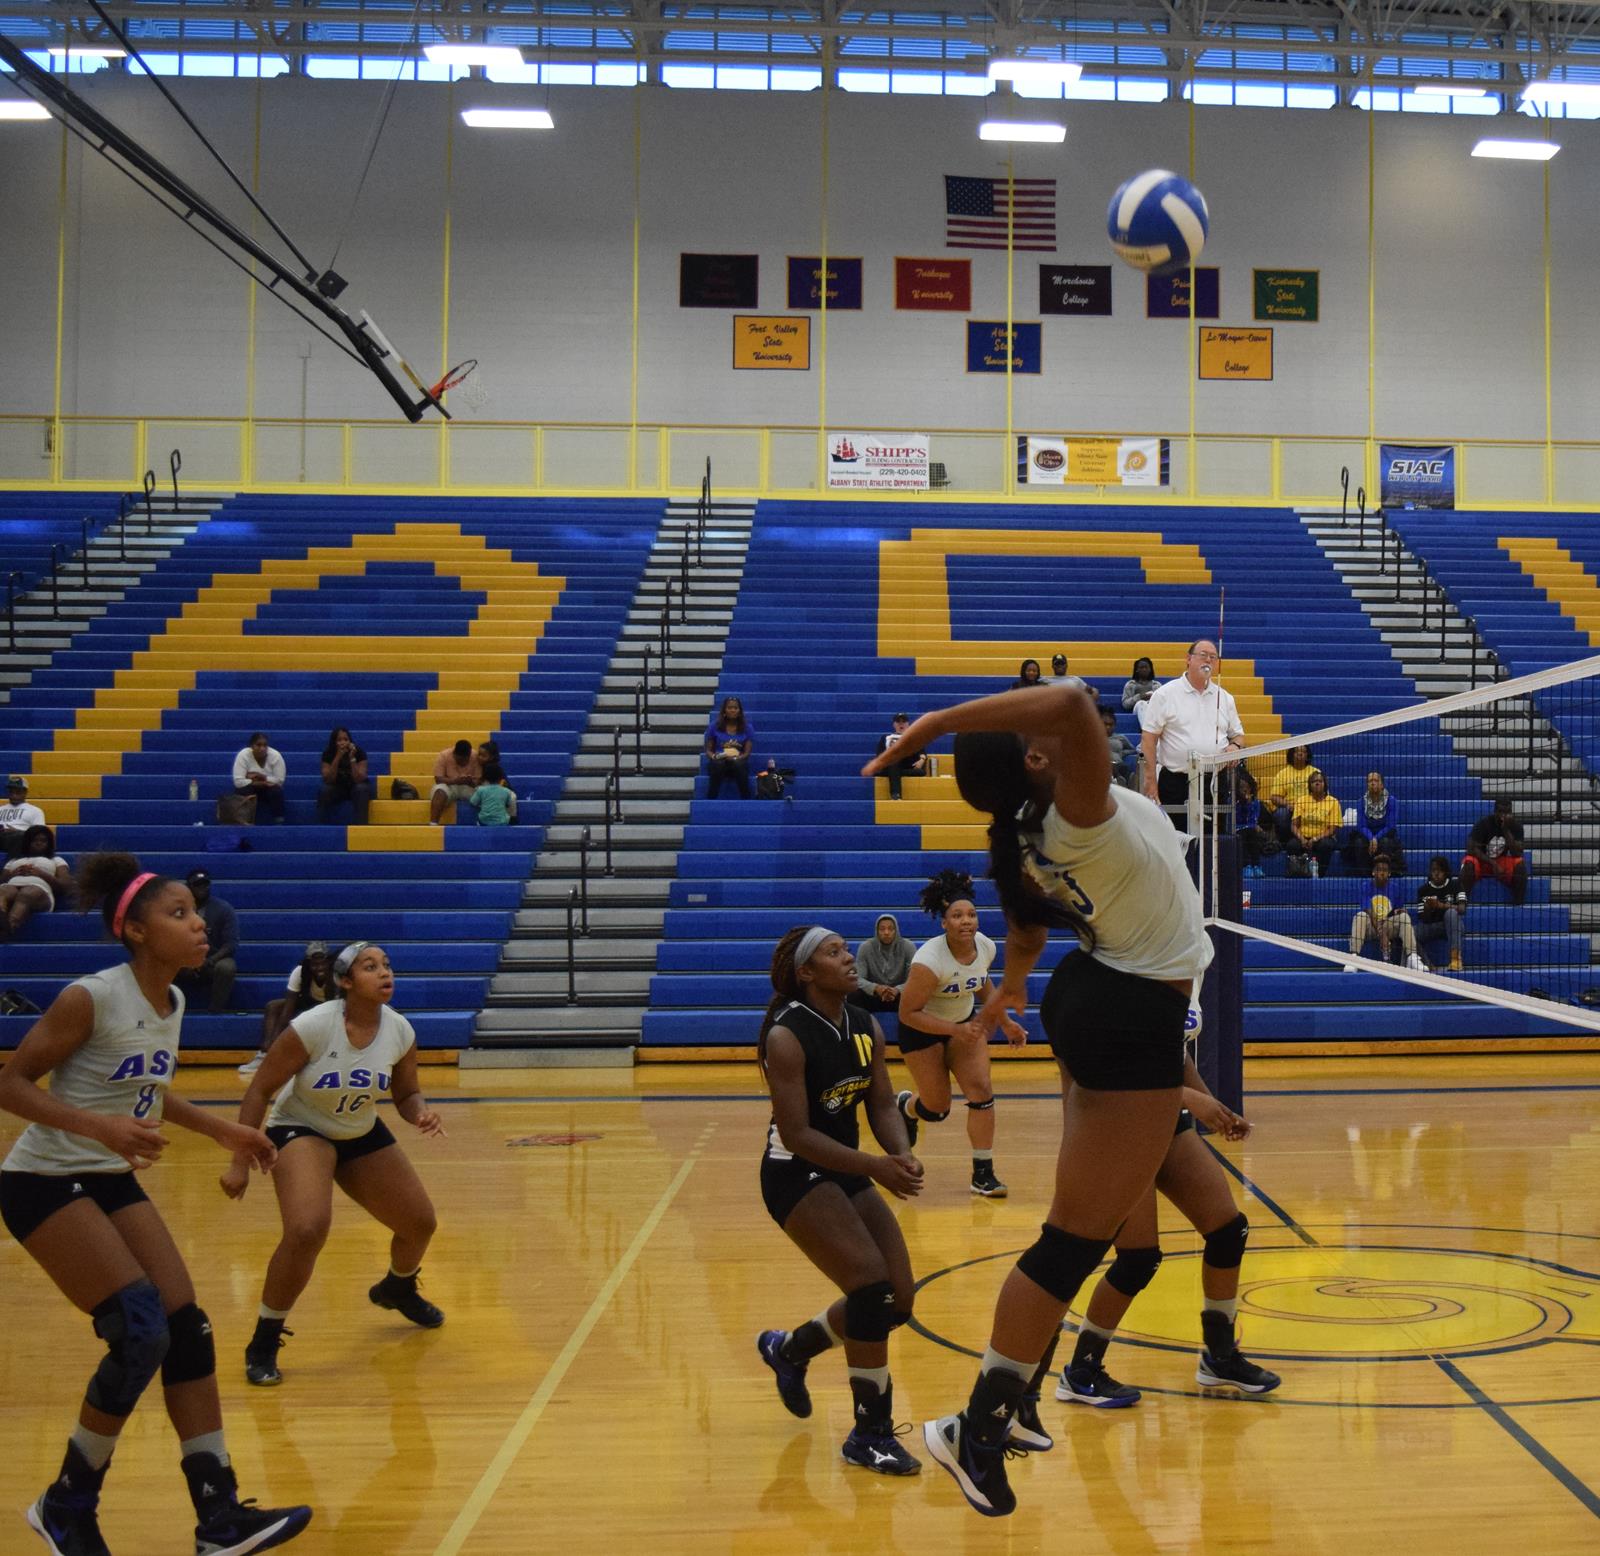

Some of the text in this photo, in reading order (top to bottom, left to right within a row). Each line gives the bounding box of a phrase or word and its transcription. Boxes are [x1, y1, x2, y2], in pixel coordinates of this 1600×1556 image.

[1052, 274, 1096, 286] Morehouse
[810, 285, 839, 300] Colege
[911, 289, 954, 303] University
[1062, 292, 1089, 307] College
[1276, 288, 1296, 302] State
[1265, 304, 1306, 318] University
[747, 323, 799, 336] Fort Valley
[762, 335, 783, 348] State
[752, 351, 793, 363] University
[1224, 360, 1250, 374] College
[865, 447, 927, 458] SHIPP'S
[1389, 459, 1445, 475] SIAC
[853, 479, 868, 487] STATE
[869, 479, 893, 487] ATHLETIC
[894, 480, 927, 488] DEPARTMENT
[107, 1049, 179, 1081] AS
[311, 1068, 392, 1092] ASU
[133, 1083, 159, 1118] 8
